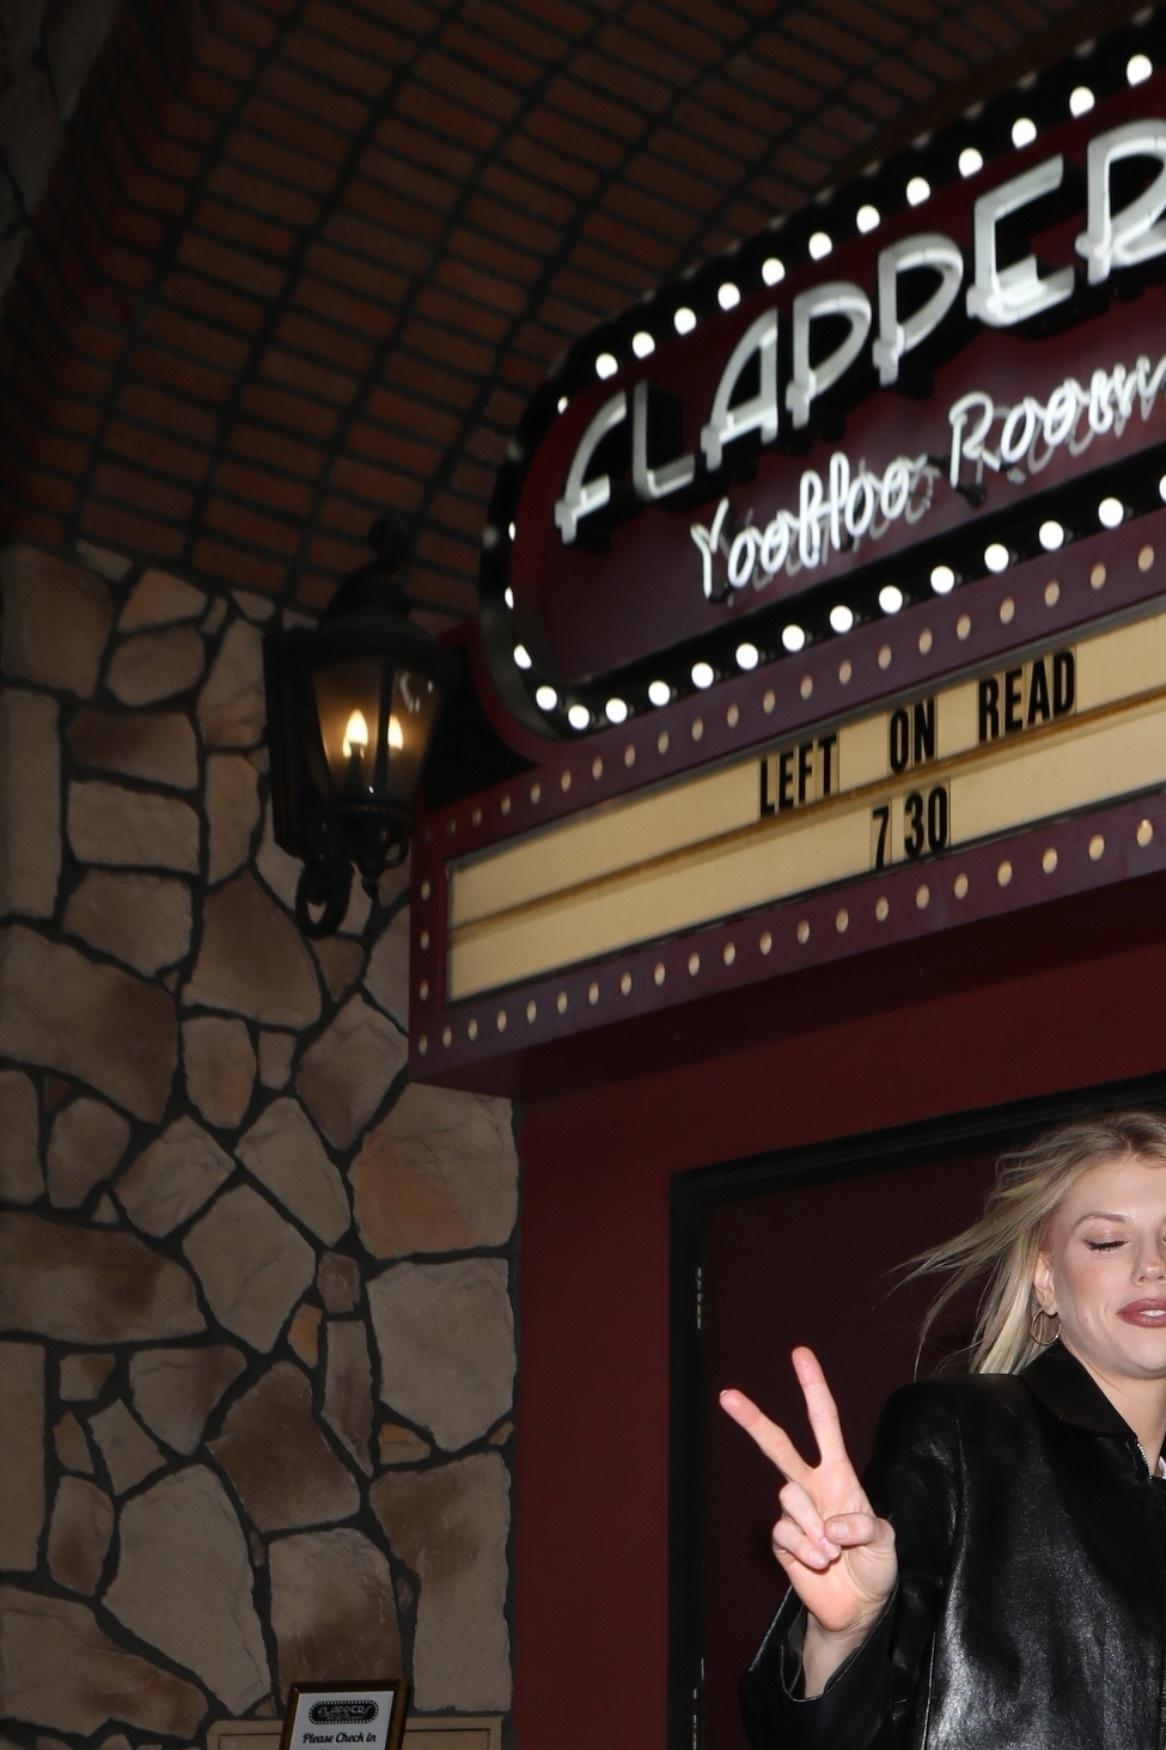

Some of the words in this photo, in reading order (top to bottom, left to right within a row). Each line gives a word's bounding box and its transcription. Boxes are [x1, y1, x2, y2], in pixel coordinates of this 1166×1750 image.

[760, 735, 837, 818] LEFT
[889, 699, 935, 774] ON
[978, 650, 1076, 743] READ
[303, 1732, 334, 1744] Please
[336, 1732, 364, 1743] Check
[366, 1732, 377, 1743] in
